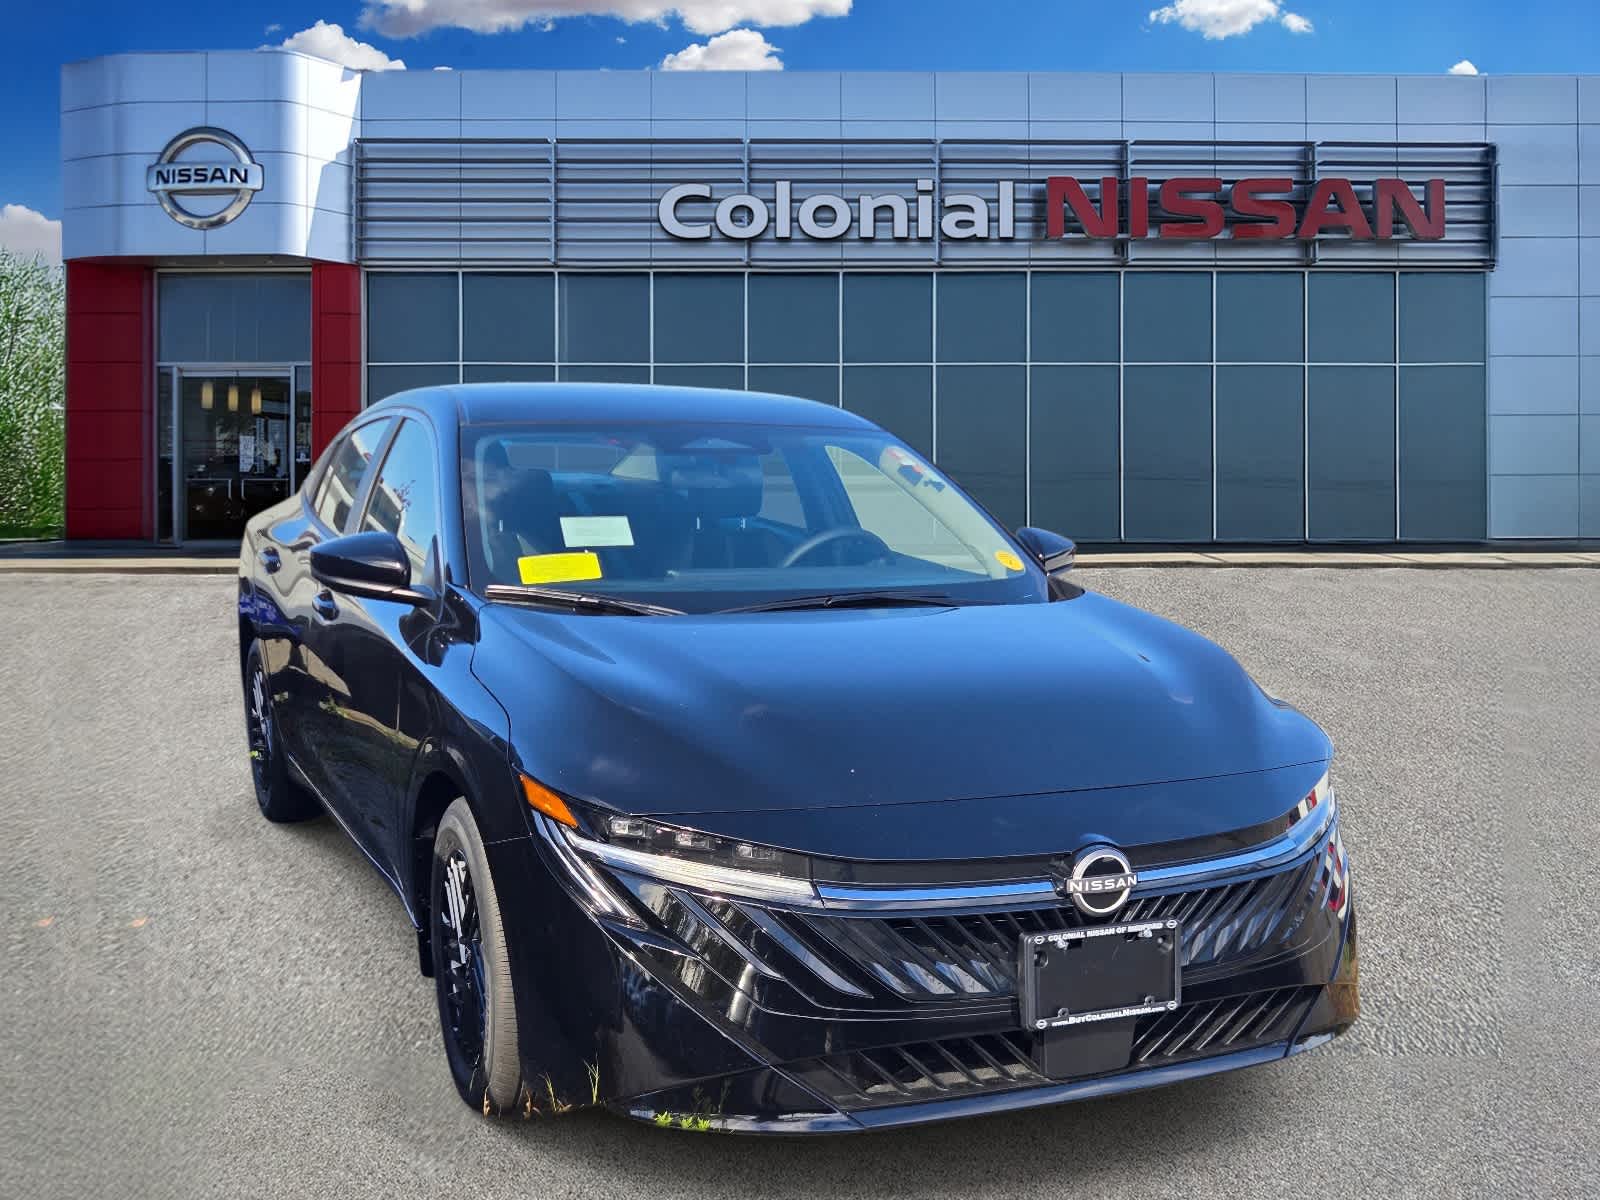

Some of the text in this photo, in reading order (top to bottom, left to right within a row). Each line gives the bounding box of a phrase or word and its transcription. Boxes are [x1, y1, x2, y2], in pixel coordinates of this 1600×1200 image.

[155, 167, 248, 185] NISSAN
[658, 176, 1446, 240] Colonial NISSAN
[1069, 874, 1138, 892] NISSAN
